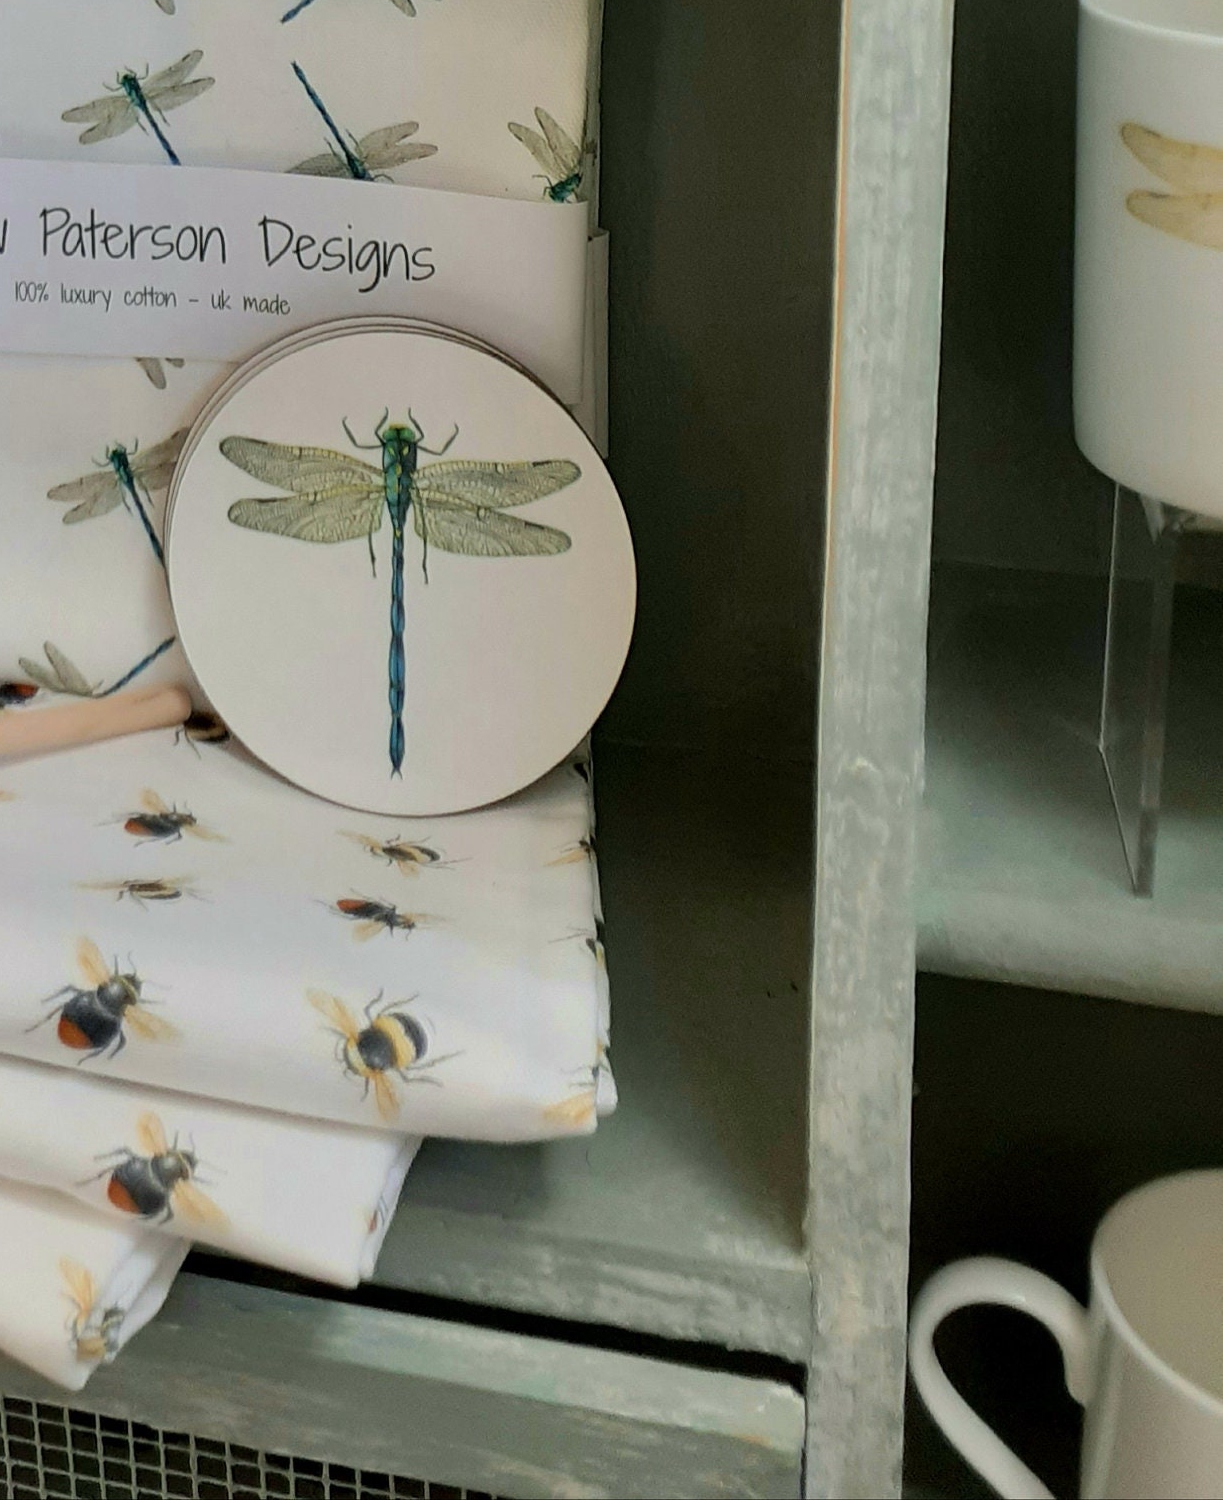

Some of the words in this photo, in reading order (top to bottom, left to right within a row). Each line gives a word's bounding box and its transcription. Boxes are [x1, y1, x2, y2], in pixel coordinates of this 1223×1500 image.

[38, 206, 227, 265] Paterson
[257, 214, 436, 293] Designs
[14, 280, 49, 303] 100%
[60, 282, 112, 313] luxury
[123, 285, 177, 308] cotton
[210, 288, 232, 311] uk
[242, 293, 291, 316] made
